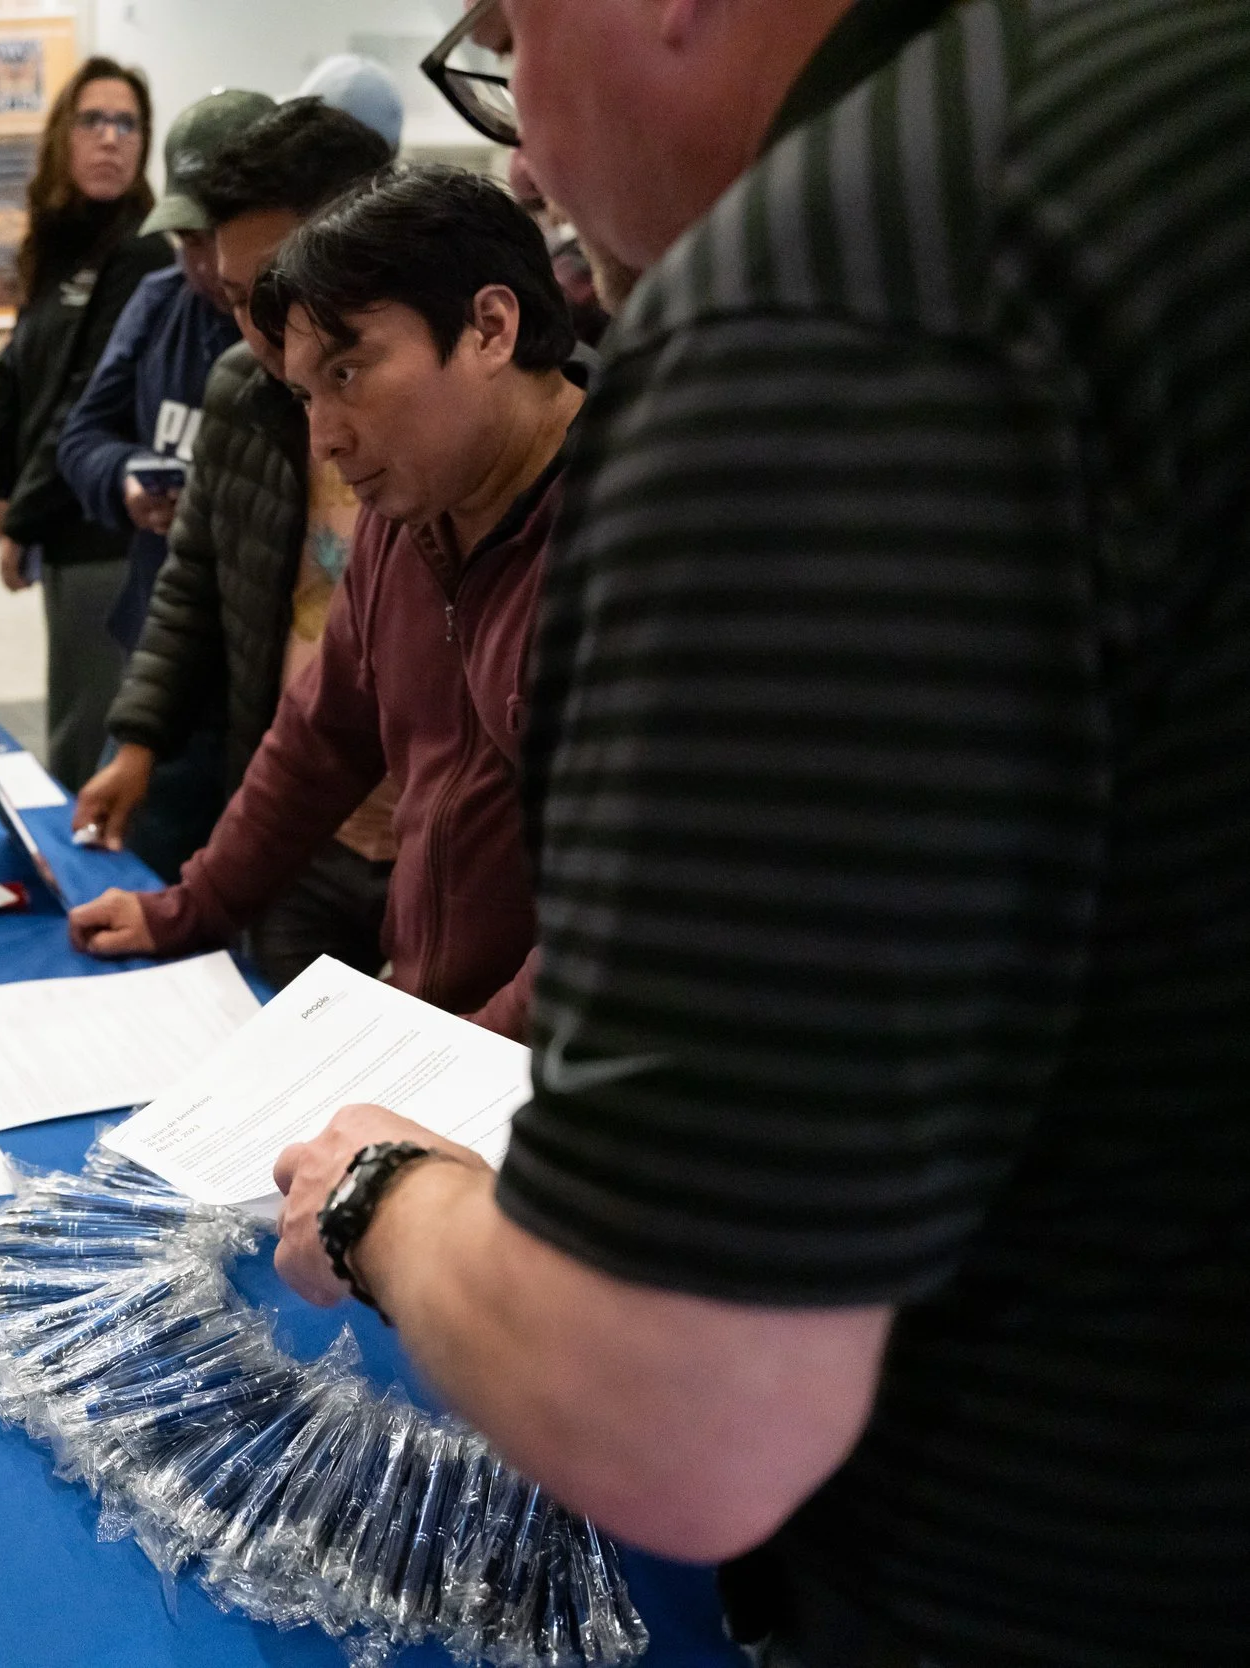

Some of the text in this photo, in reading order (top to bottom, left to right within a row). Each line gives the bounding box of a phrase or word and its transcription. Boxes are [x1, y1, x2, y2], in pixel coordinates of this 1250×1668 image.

[301, 995, 331, 1020] people
[175, 1095, 213, 1121] beneficios
[155, 1139, 175, 1153] Abril
